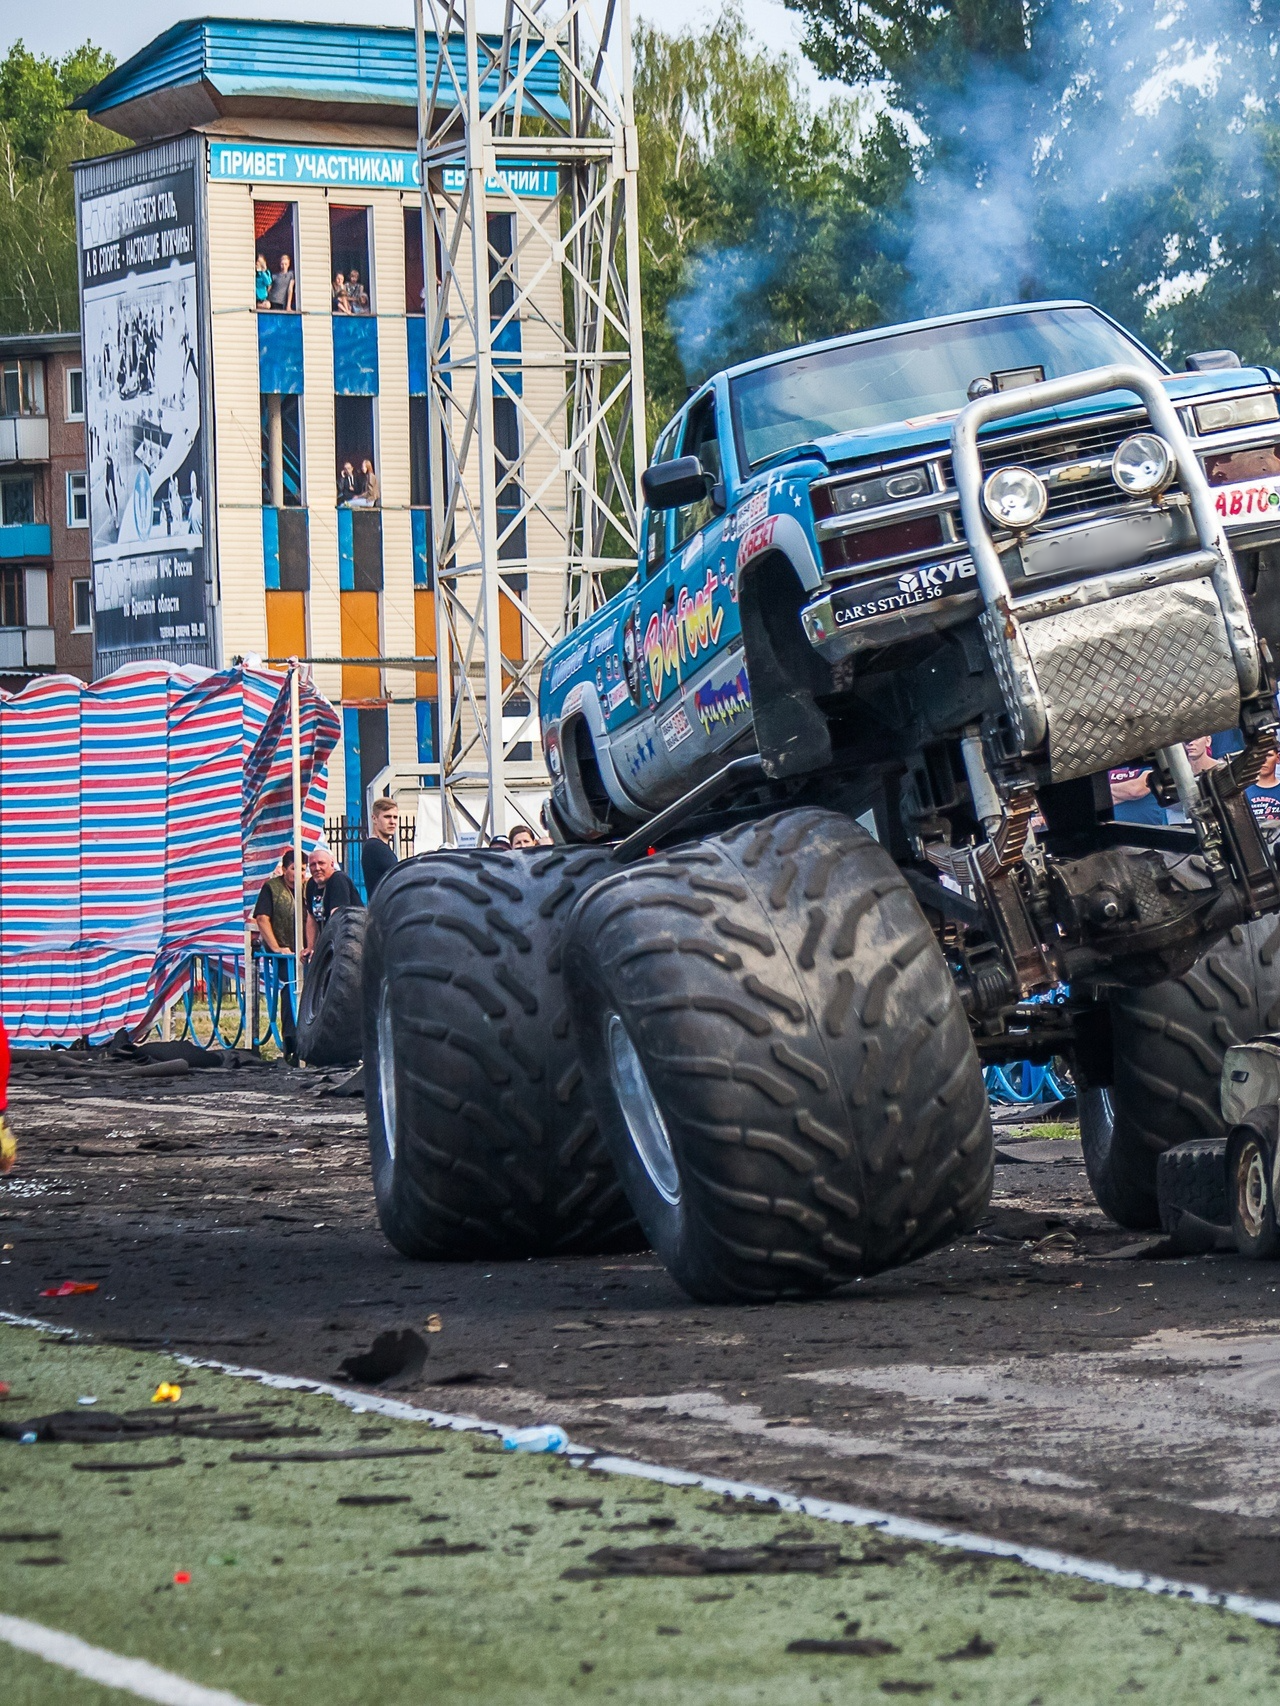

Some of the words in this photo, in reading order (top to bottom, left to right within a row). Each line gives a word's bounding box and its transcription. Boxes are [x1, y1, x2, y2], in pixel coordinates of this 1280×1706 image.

[220, 150, 287, 177] ПРИВЕТ
[294, 153, 404, 184] УЧАСТНИКАМ
[98, 243, 121, 275] СПОРТЕ
[1215, 487, 1270, 517] АВТО
[919, 557, 978, 589] КУБ
[878, 590, 925, 612] STYLE
[926, 585, 943, 599] 56
